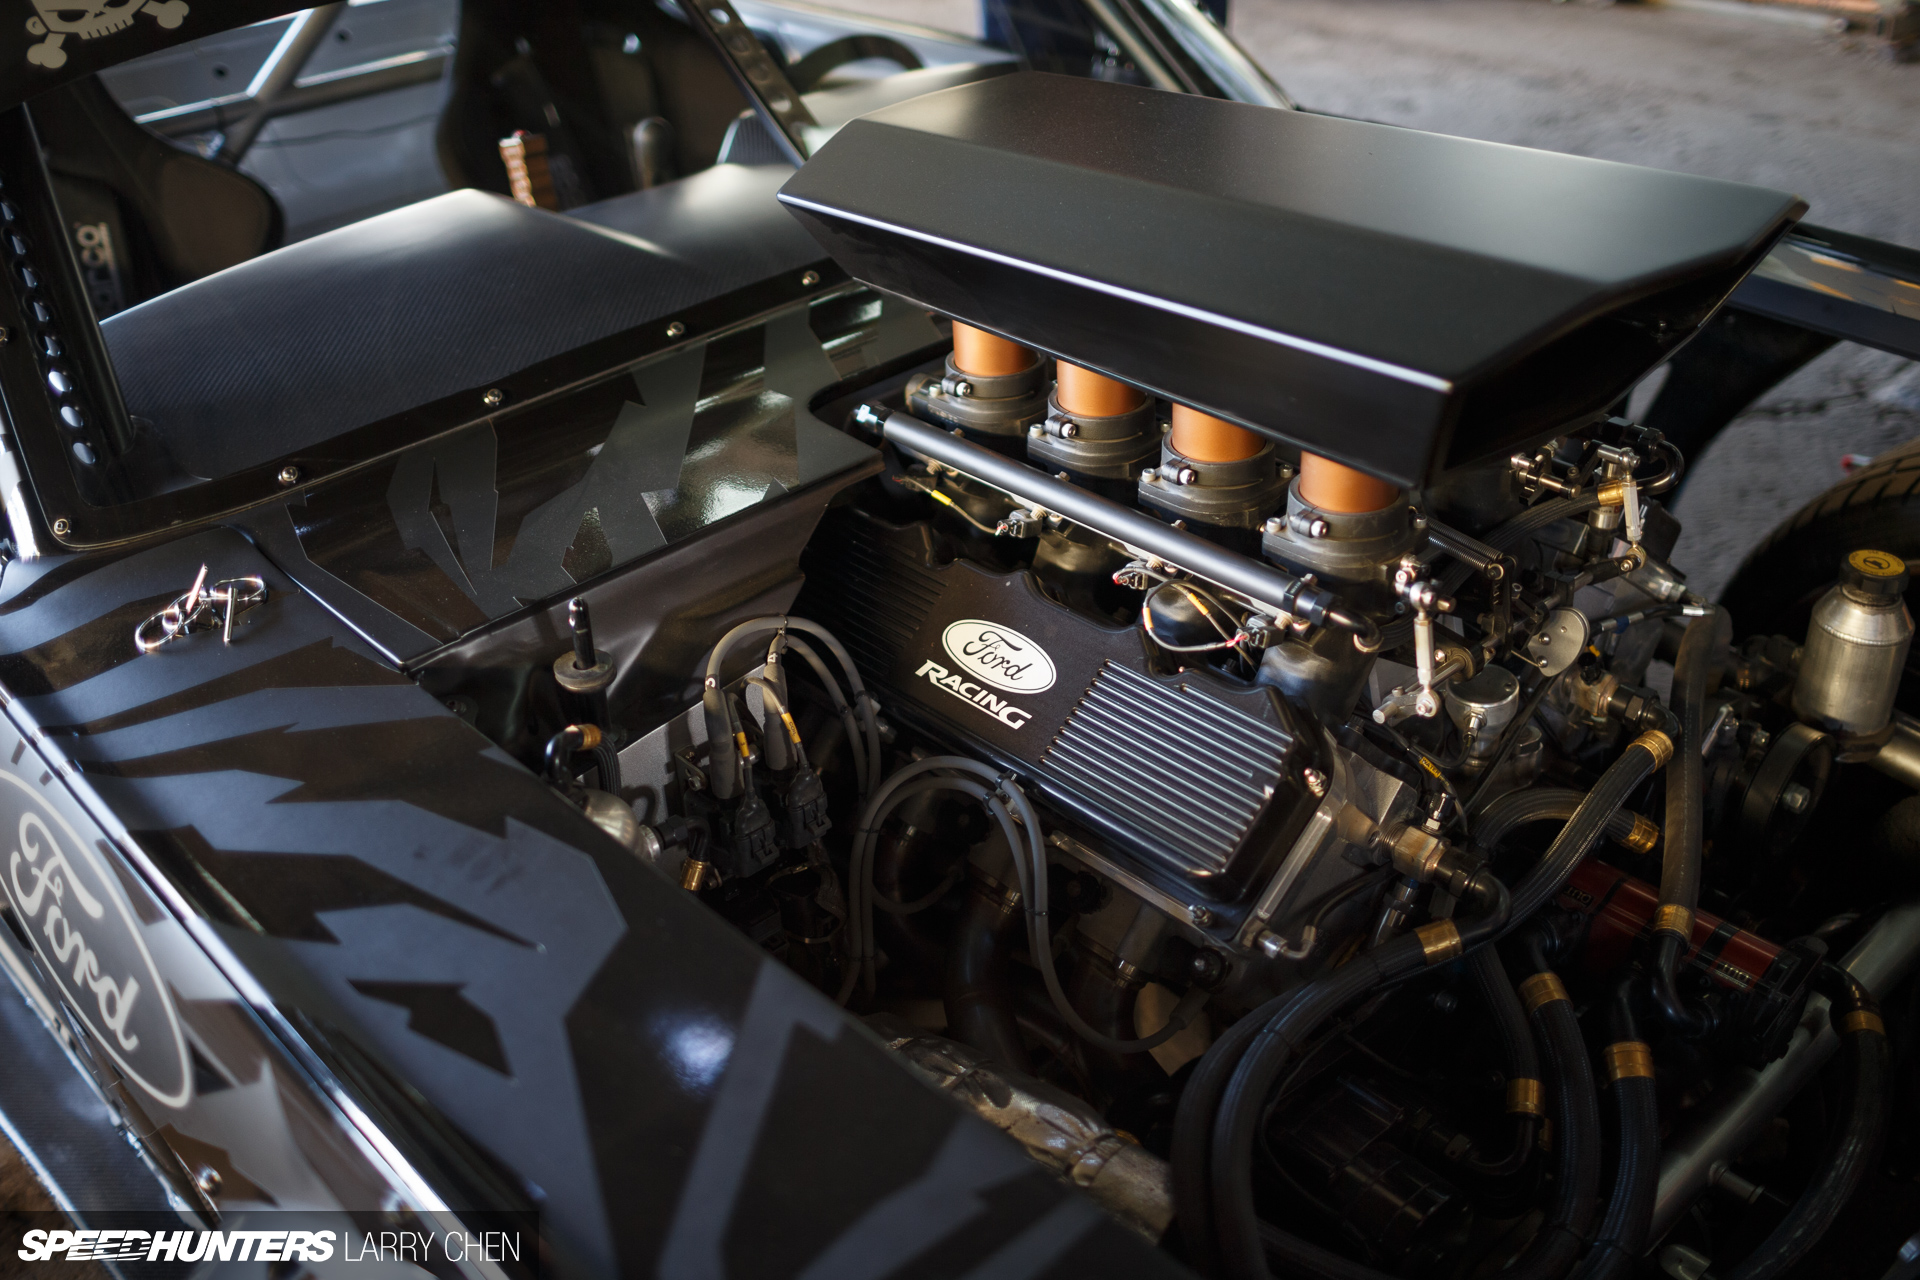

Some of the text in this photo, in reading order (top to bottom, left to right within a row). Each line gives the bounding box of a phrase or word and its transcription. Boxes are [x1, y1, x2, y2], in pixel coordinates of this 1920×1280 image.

[767, 652, 778, 663] 4
[962, 630, 1033, 681] Ford
[915, 658, 1033, 730] RACING
[10, 811, 141, 1052] Ford
